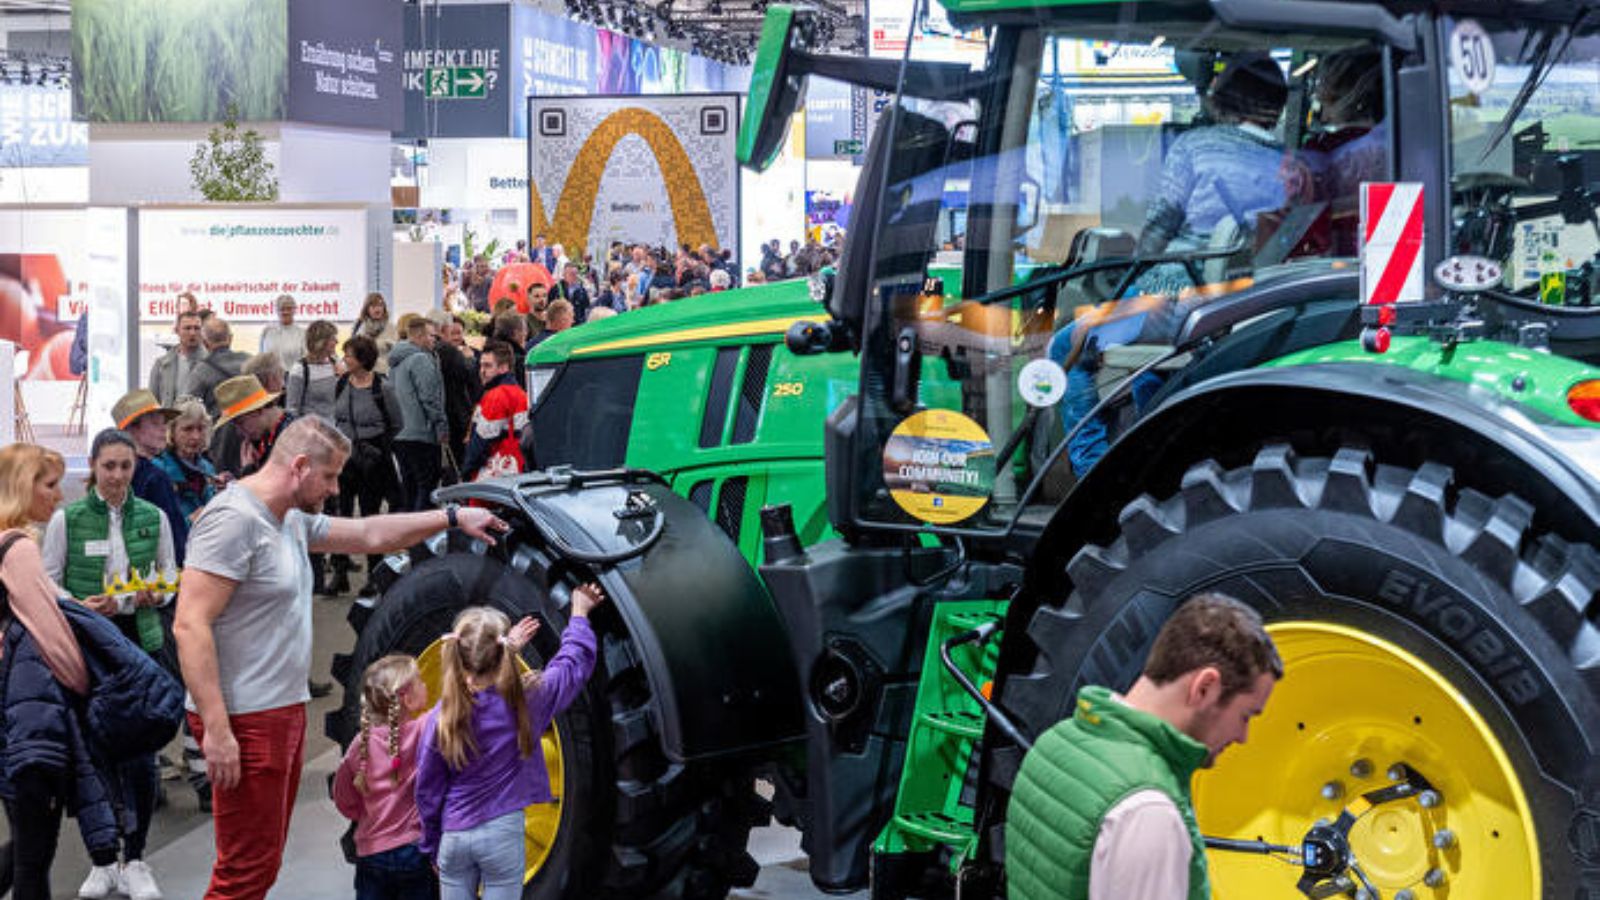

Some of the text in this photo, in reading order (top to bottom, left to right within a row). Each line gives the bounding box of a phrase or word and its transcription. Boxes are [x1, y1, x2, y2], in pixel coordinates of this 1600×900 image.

[471, 49, 499, 68] DIE
[1460, 34, 1488, 79] 50
[205, 281, 278, 294] Landwirtschaft
[282, 281, 298, 292] der
[302, 281, 340, 292] Zukunft
[646, 352, 672, 371] 6R
[773, 382, 804, 397] 250
[899, 465, 979, 485] COMMUNITY!
[1378, 569, 1541, 705] EVOBIB
